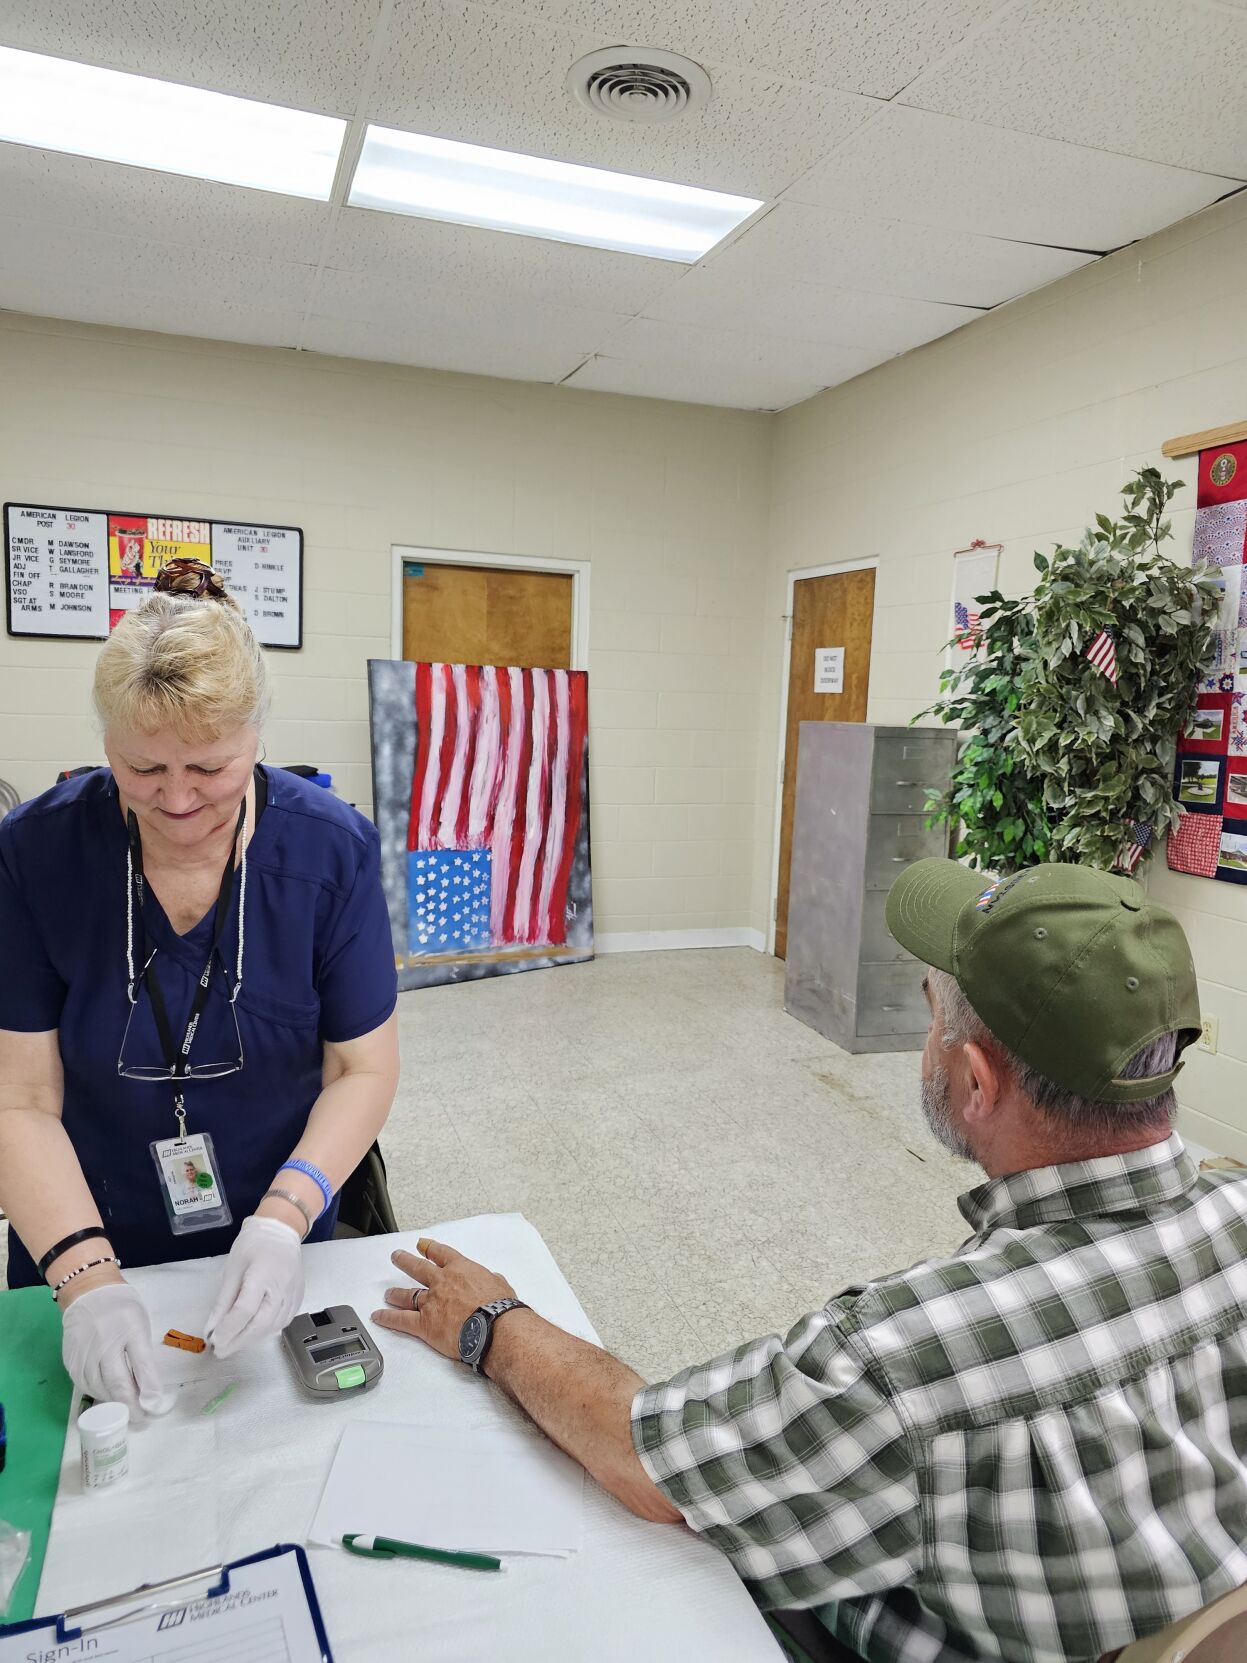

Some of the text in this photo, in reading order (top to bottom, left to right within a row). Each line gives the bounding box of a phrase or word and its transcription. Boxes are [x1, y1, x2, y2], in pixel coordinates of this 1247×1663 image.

[20, 510, 90, 522] AMERICAN LEGION
[36, 520, 54, 528] POST
[147, 517, 211, 544] REFRESH
[223, 527, 286, 538] AMERICAN LEGION
[11, 536, 34, 544] CMDR
[58, 540, 90, 549] DAWSON
[150, 541, 182, 555] Your
[22, 546, 39, 554] VICE
[59, 549, 94, 558] LANSFORD
[59, 557, 90, 566] SEYMORE
[214, 559, 233, 568] PRES
[13, 562, 26, 570] ADJ
[59, 566, 99, 575] GALLAGHER
[13, 571, 25, 579] FIN
[12, 579, 33, 588] CHAP
[59, 582, 94, 591] BRANDON
[113, 586, 144, 594] MEETING
[12, 588, 85, 599] VSO S MOORE
[263, 595, 288, 603] DALTON
[21, 604, 43, 612] ARMS
[60, 604, 92, 612] JOHNSON
[262, 610, 285, 618] BROWN
[174, 1196, 199, 1206] NORAH
[240, 1589, 279, 1606] CENTER
[26, 1638, 98, 1663] Sign-In
